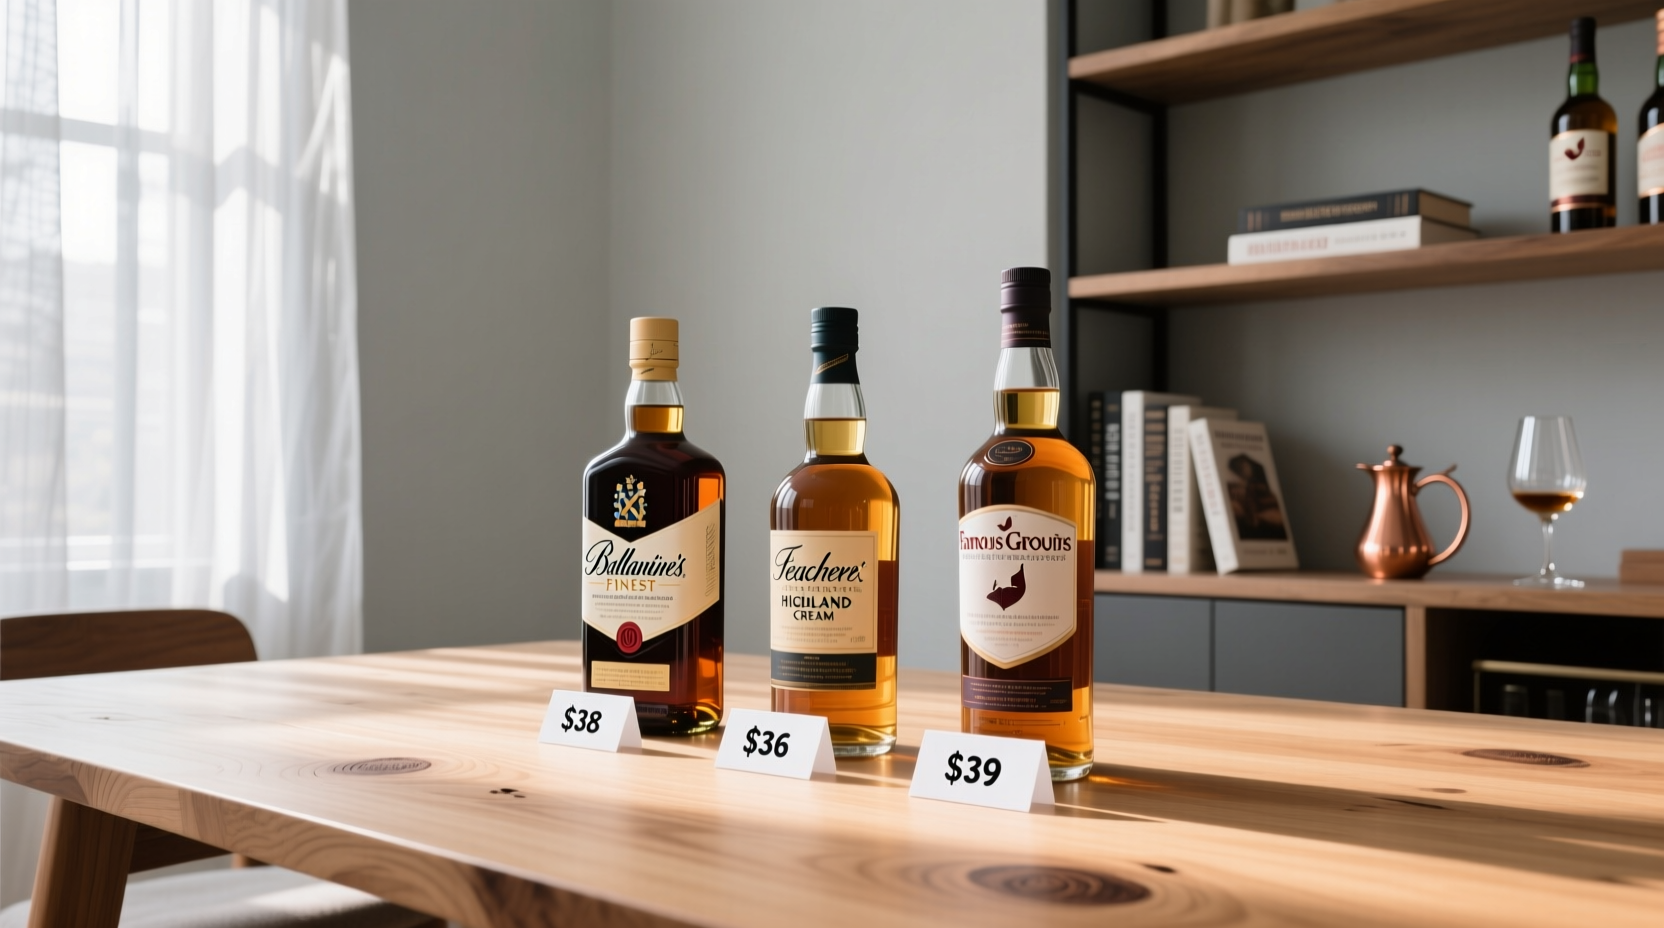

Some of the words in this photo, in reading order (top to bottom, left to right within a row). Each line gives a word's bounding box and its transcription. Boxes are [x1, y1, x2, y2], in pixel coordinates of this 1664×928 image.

[606, 578, 656, 592] FINEST
[793, 610, 835, 621] CREAM
[561, 704, 602, 733] $38
[743, 725, 790, 757] $36
[944, 750, 1002, 786] $39
